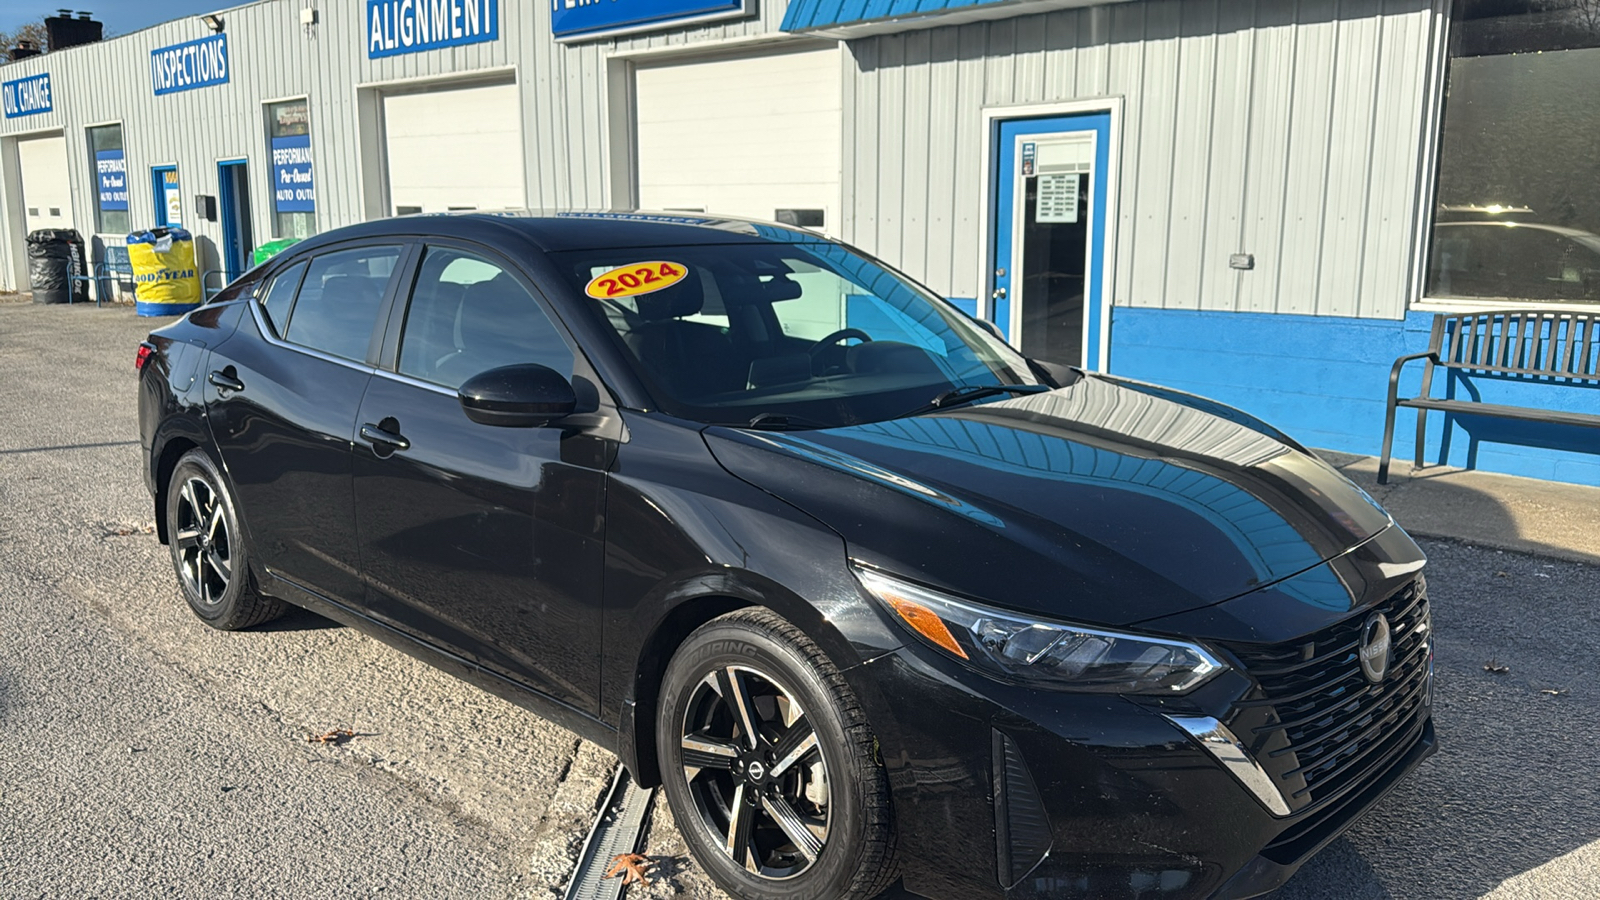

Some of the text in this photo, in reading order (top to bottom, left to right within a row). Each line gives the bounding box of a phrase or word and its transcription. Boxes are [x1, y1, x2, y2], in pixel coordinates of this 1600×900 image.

[370, 0, 491, 53] ALIGNMENT
[152, 38, 226, 91] INSPECTIONS
[4, 76, 51, 115] OIL CHANGE
[281, 168, 312, 184] Pre-Owned
[276, 188, 294, 201] AUTO
[598, 263, 680, 296] 2024
[1361, 639, 1386, 659] NISS
